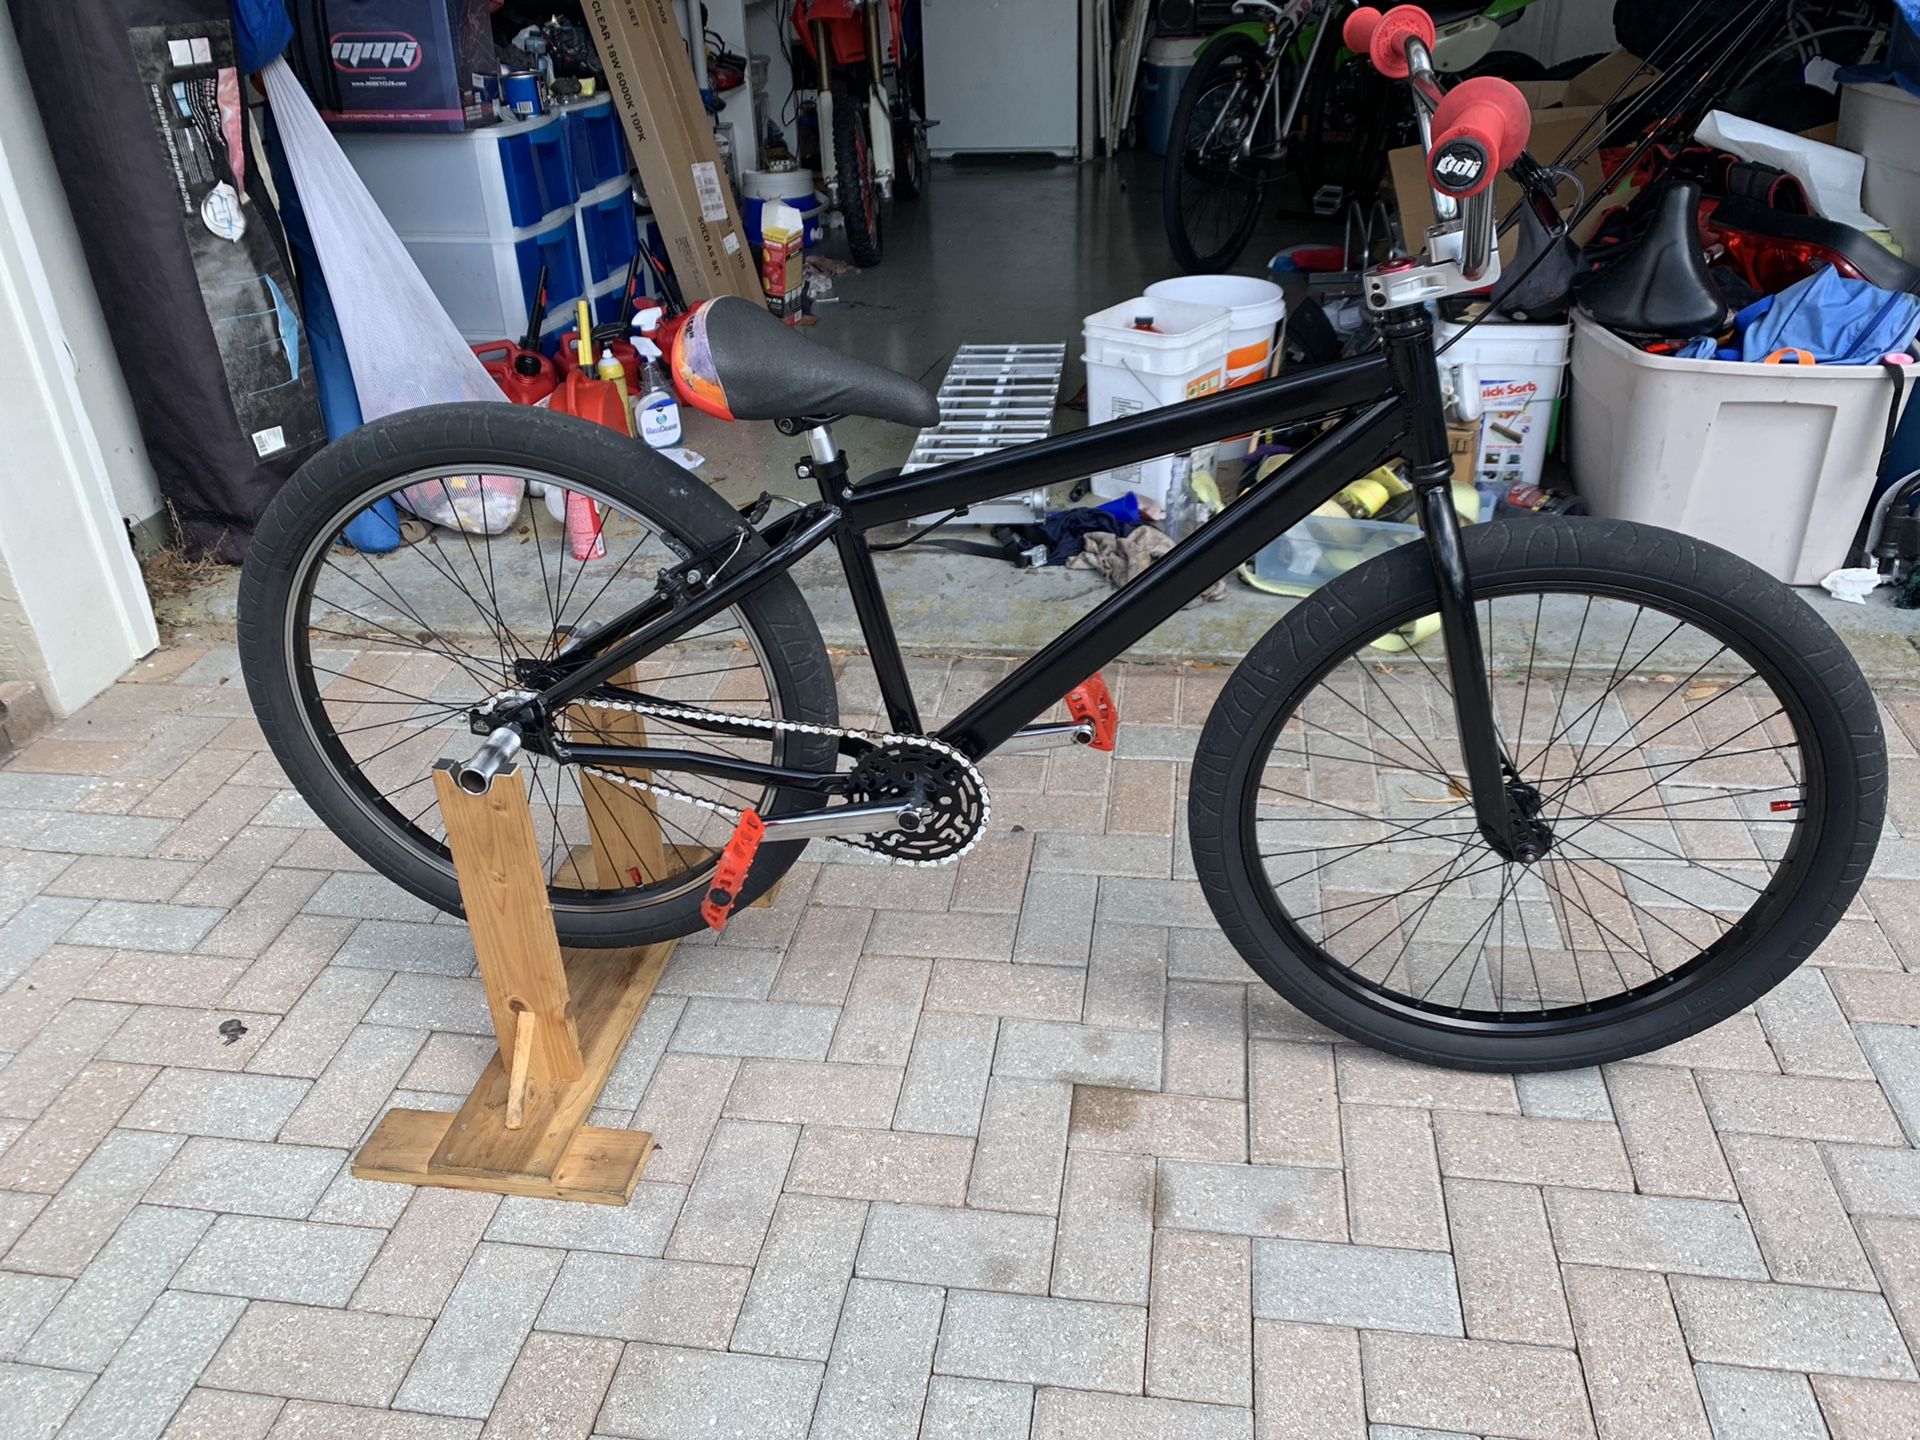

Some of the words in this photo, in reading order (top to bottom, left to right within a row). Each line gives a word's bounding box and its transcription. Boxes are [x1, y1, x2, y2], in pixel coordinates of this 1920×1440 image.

[591, 1, 610, 40] CLEAR
[607, 43, 621, 69] 18W
[616, 72, 635, 109] 6000K
[631, 112, 647, 142] 10PK
[698, 216, 710, 242] SOLD
[706, 244, 715, 257] AS
[712, 259, 721, 276] SET
